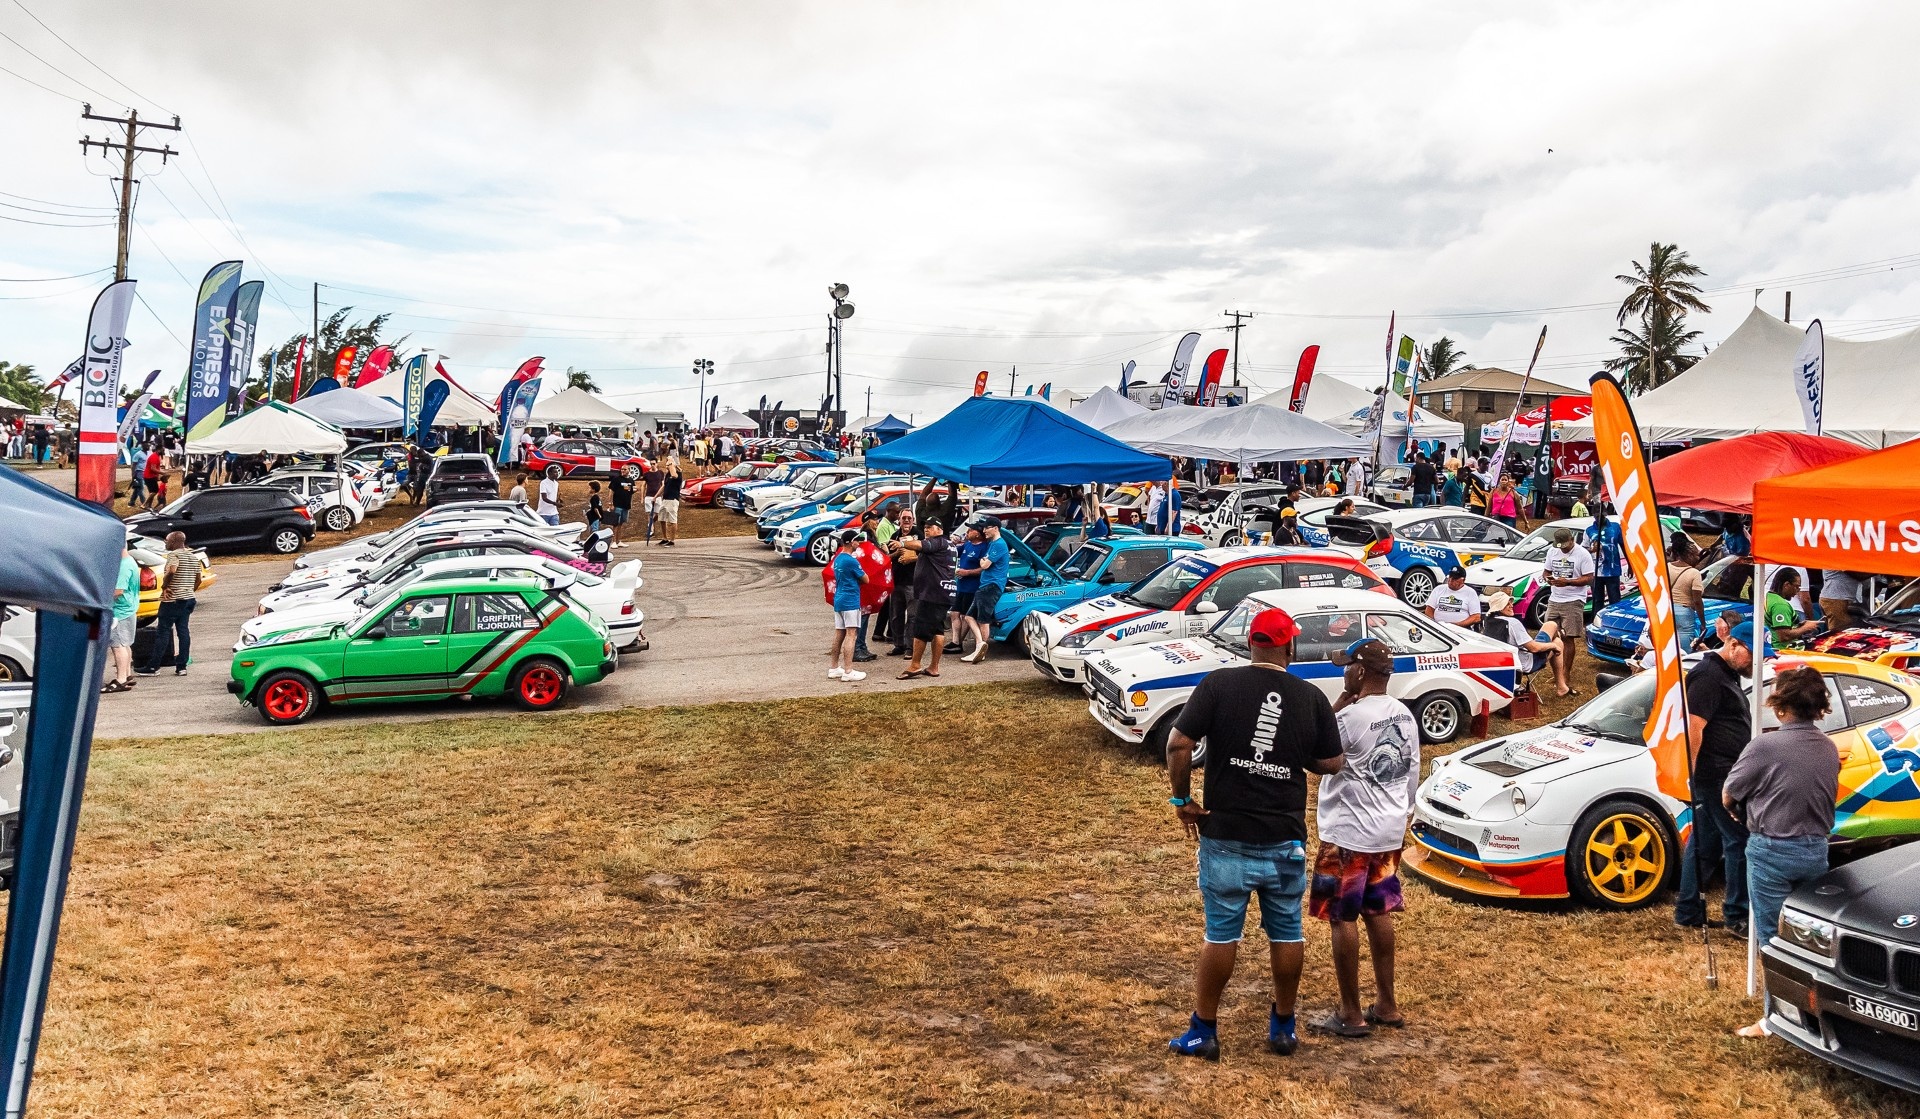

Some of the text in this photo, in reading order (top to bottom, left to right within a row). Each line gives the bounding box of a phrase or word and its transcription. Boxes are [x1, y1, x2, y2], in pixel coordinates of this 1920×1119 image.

[203, 305, 229, 398] EXPRESS
[84, 334, 114, 408] BCIC
[107, 336, 122, 408] RETHINK INSURANCE
[192, 339, 207, 398] MOTORS
[1165, 359, 1185, 402] BCIC
[1399, 542, 1447, 559] Procters
[477, 622, 522, 630] R.JORDAN
[1123, 620, 1169, 638] Valvoline
[1417, 653, 1457, 664] British
[1417, 661, 1459, 671] airways
[1098, 659, 1122, 676] Shell
[1852, 686, 1877, 696] Brook
[1546, 739, 1586, 755] Clubman
[1229, 757, 1292, 774] SUSPENSION
[1488, 841, 1520, 850] Motorsport
[1493, 834, 1520, 842] Clubman
